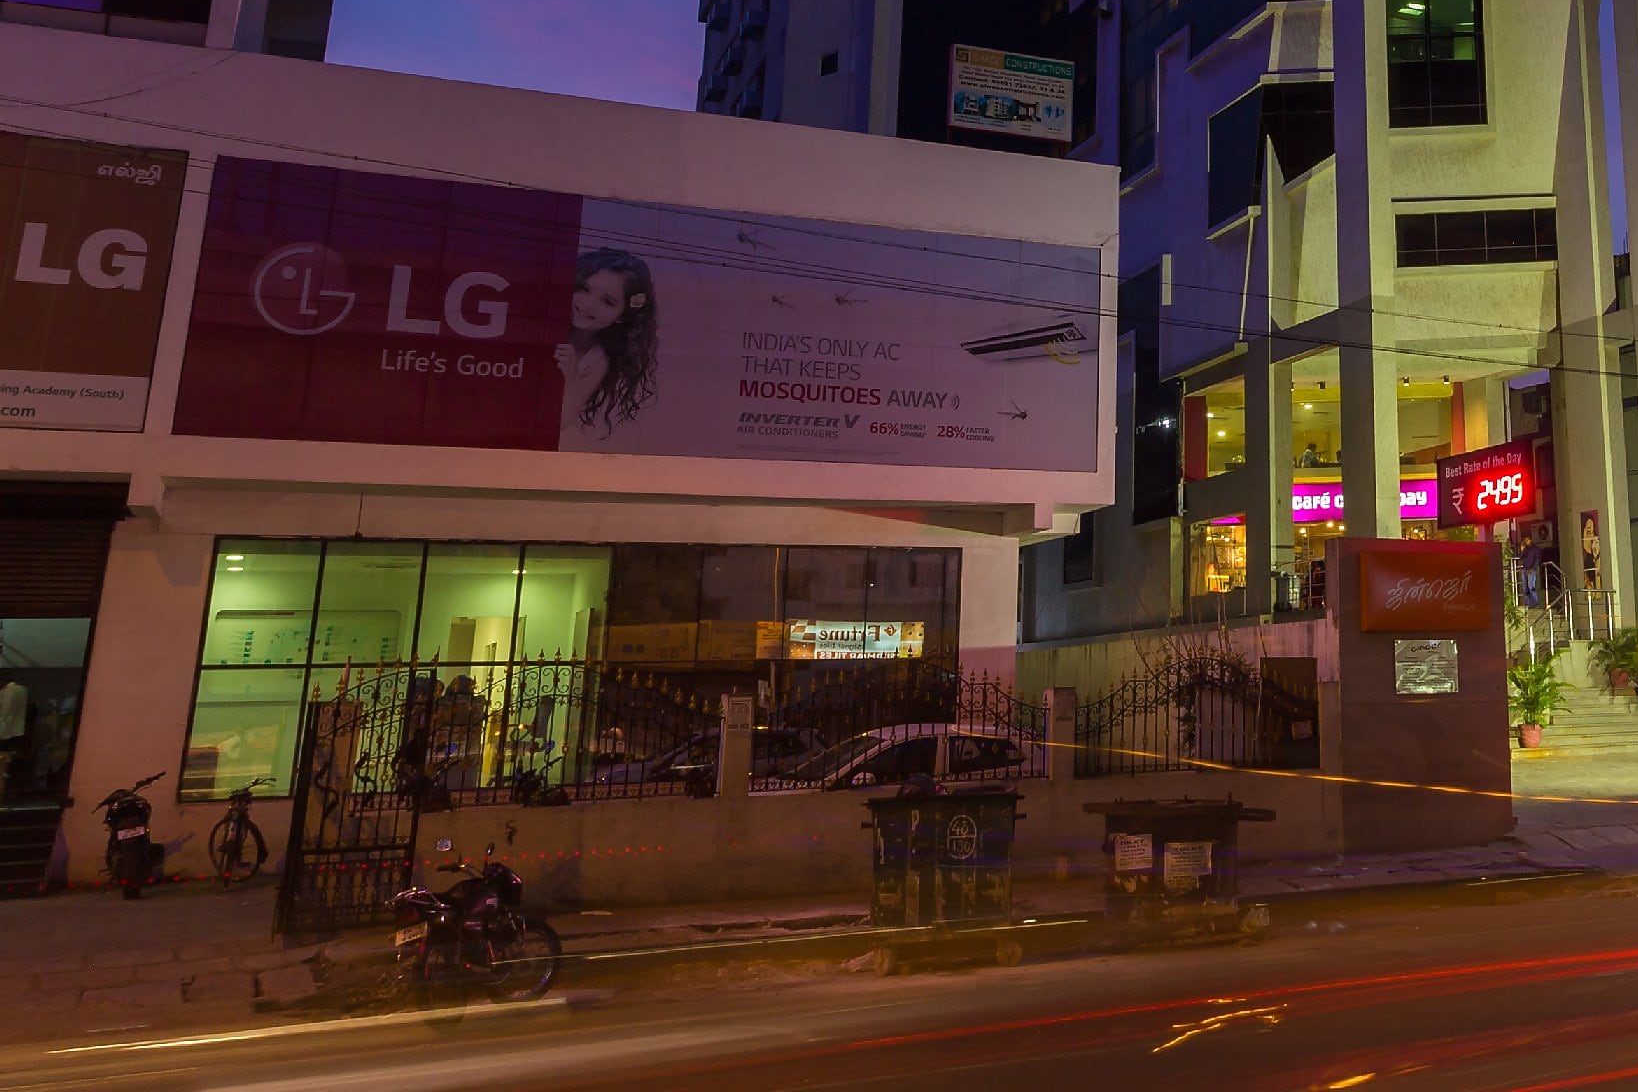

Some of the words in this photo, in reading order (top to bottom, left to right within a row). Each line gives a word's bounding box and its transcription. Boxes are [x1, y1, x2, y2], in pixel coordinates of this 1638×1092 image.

[1005, 58, 1072, 76] CONSTRUCTIONS
[15, 222, 148, 291] LG
[386, 265, 511, 338] LG
[817, 337, 869, 358] ONLY
[873, 342, 901, 360] AC
[457, 354, 525, 378] Good
[742, 355, 794, 376] THAT
[799, 360, 862, 381] KEEPS
[23, 385, 78, 399] Academy
[79, 388, 125, 400] (South)
[739, 379, 881, 406] MOSQUITOES
[886, 389, 948, 409] AWAY
[739, 411, 840, 428] INVERTER
[843, 414, 861, 429] V
[868, 421, 899, 436] 66%
[736, 425, 755, 436] AIR
[757, 426, 839, 440] CONDITIONERS
[936, 425, 965, 439] 28%
[1445, 465, 1462, 479] Best
[1463, 461, 1481, 475] Rate
[1482, 459, 1491, 469] of
[1492, 455, 1506, 468] the
[1506, 451, 1522, 465] Day
[1477, 473, 1522, 511] 2495
